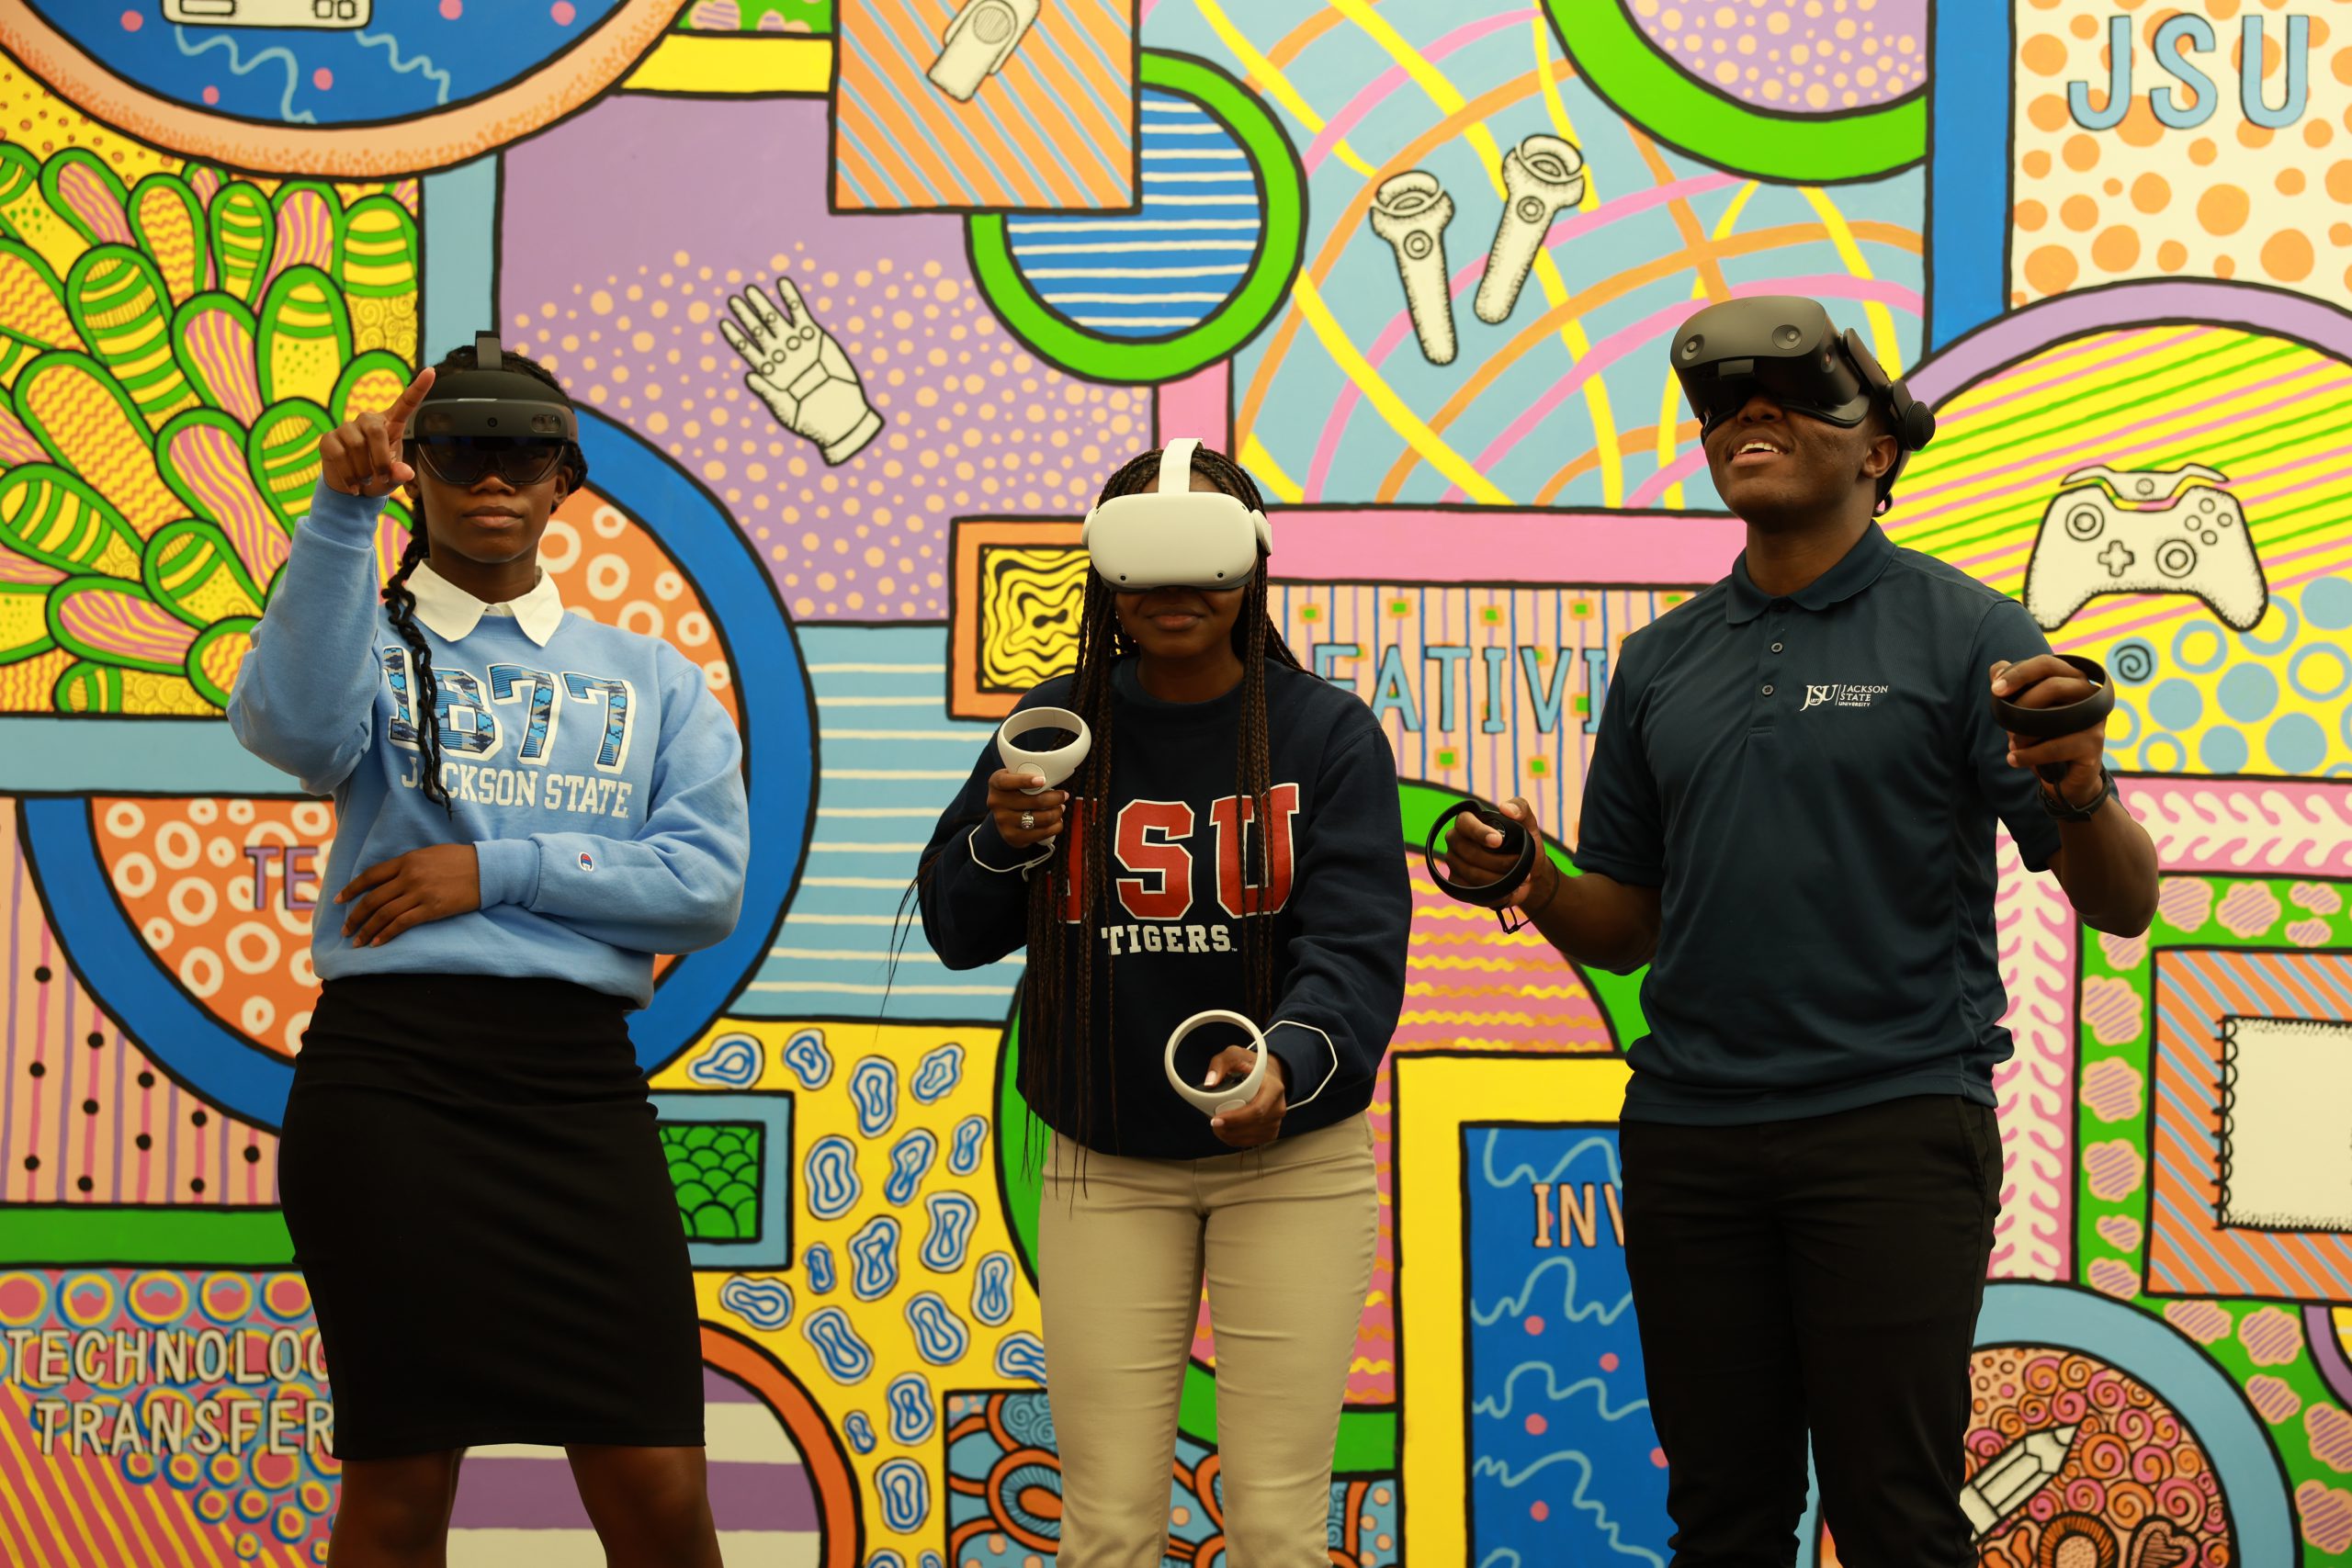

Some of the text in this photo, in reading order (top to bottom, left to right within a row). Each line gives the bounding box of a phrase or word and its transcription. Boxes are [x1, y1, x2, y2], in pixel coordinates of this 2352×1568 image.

[2067, 13, 2310, 130] JSU
[383, 645, 636, 774] 1877
[1800, 684, 1838, 711] JSU
[1839, 684, 1888, 694] JACKSON
[1839, 694, 1871, 702] STATE
[401, 756, 632, 818] JCKSON STATE
[243, 846, 319, 910] TE
[1101, 924, 1231, 955] TIGERS
[35, 1399, 334, 1456] TRANSFER
